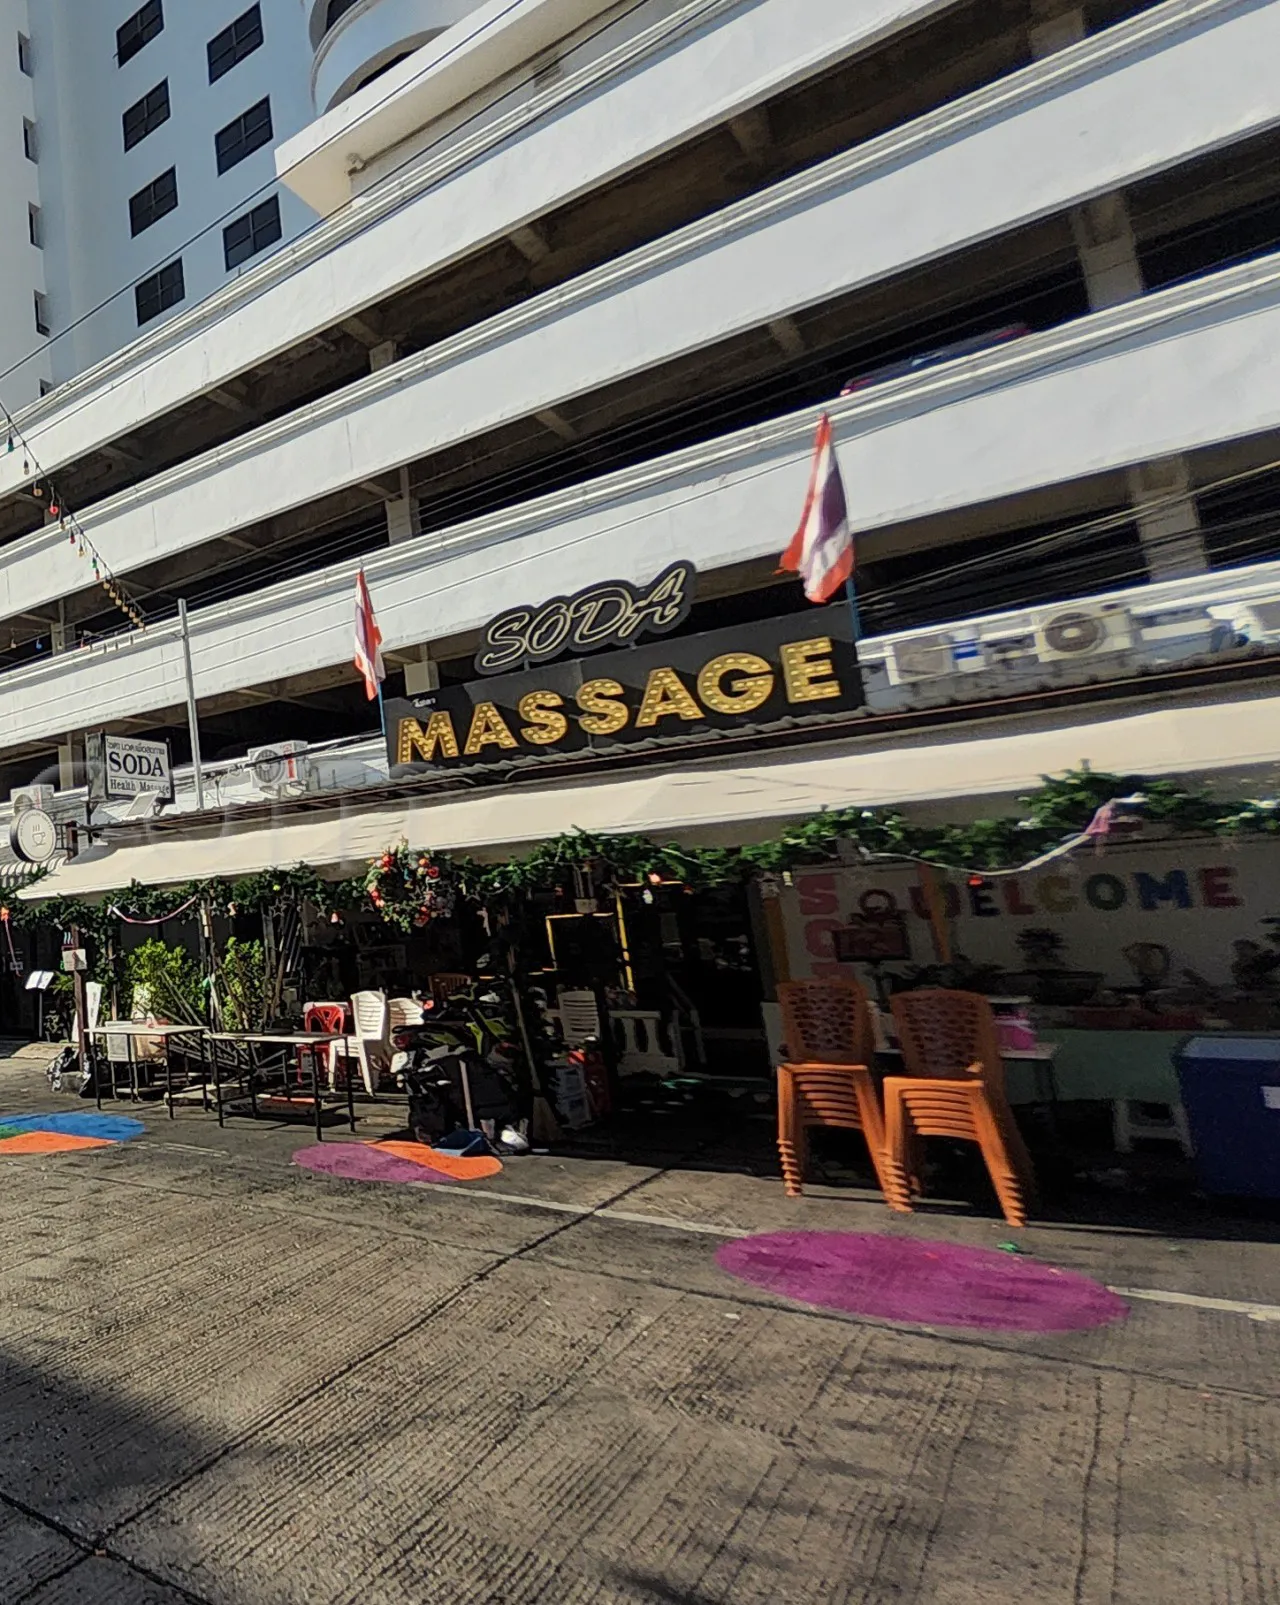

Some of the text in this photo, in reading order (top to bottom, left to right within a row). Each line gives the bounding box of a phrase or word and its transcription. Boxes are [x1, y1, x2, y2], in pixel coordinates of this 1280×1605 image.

[481, 567, 687, 668] SODA
[396, 636, 842, 764] MASSAGE
[109, 751, 165, 777] SODA
[110, 779, 170, 797] Health Massage
[908, 866, 1244, 921] WELCOME
